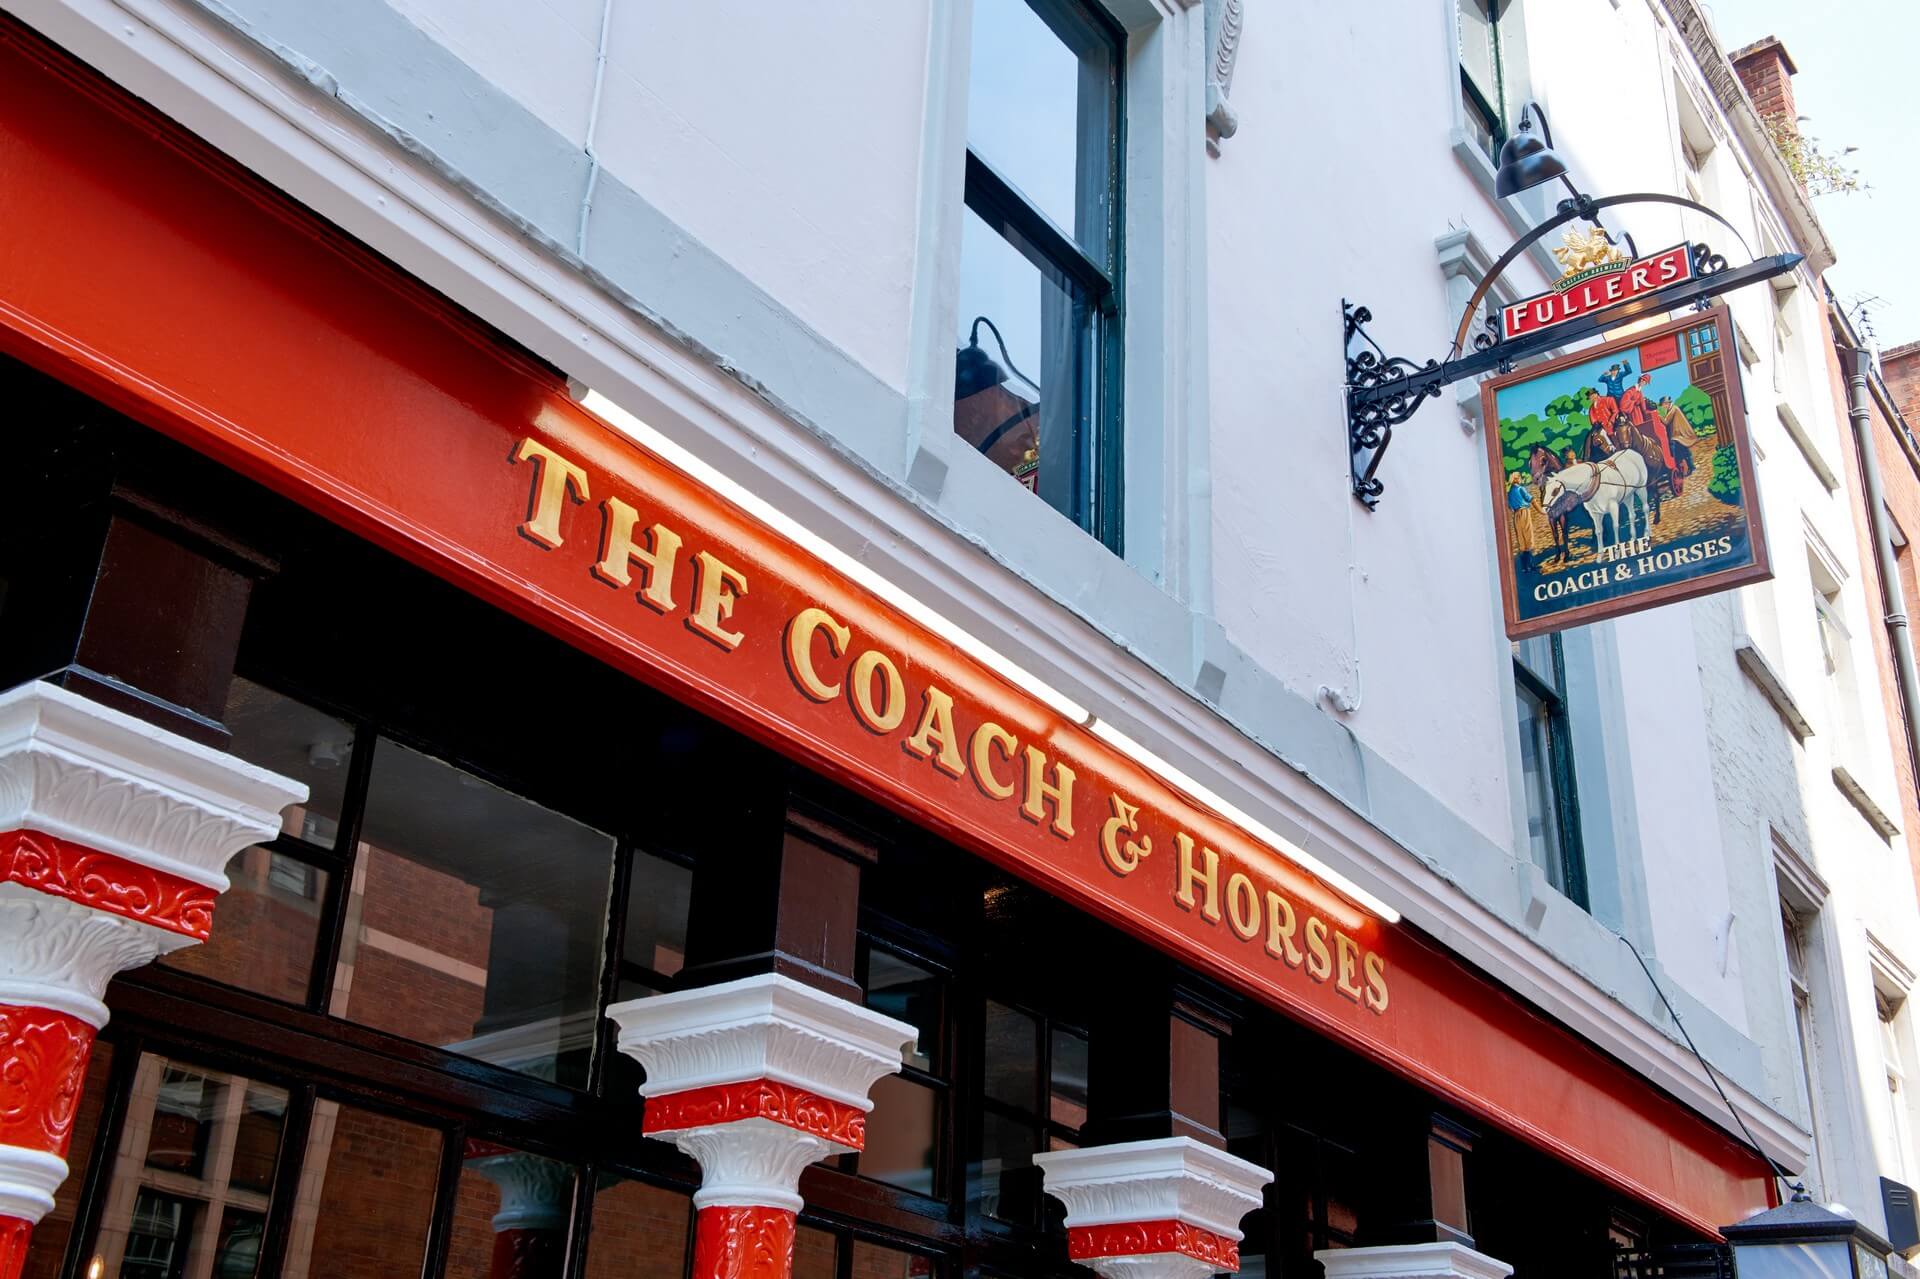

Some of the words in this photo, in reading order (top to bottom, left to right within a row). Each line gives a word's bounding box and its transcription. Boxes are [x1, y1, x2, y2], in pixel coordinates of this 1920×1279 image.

[1513, 256, 1677, 330] FULLER'S
[1591, 263, 1622, 275] BREWERY
[1534, 568, 1609, 601] COACH
[1614, 563, 1633, 581] &
[1638, 535, 1732, 576] HORSES
[1603, 536, 1651, 562] THE
[516, 437, 749, 649] THE
[786, 607, 1076, 838] COACH
[1102, 793, 1152, 874] &
[1176, 831, 1391, 1013] HORSES
